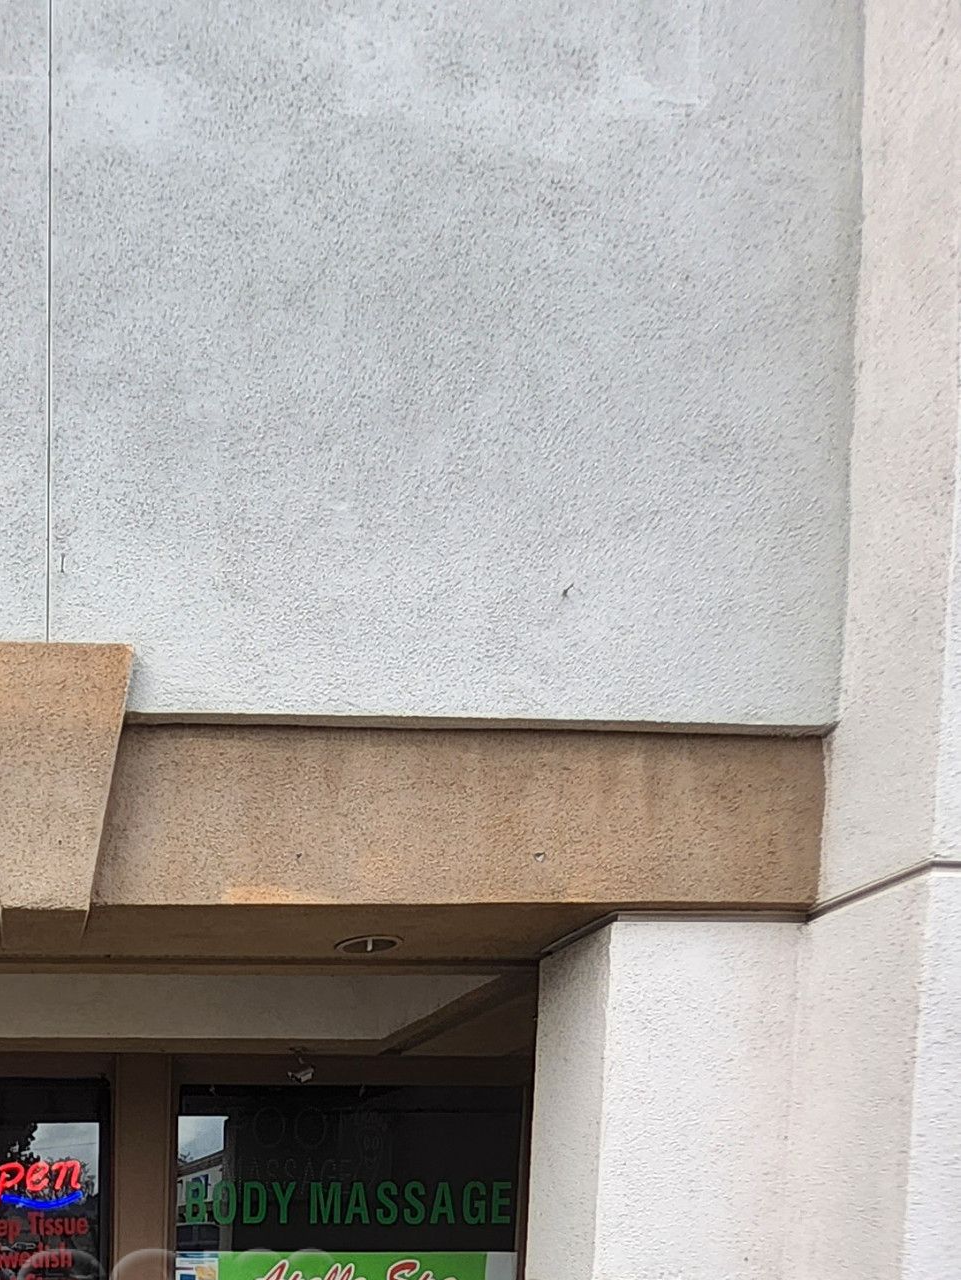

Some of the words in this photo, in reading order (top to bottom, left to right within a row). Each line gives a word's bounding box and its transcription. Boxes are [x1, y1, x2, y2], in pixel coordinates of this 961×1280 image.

[184, 1181, 297, 1225] BODY
[309, 1181, 512, 1225] MASSAGE
[27, 1212, 89, 1237] Tissue
